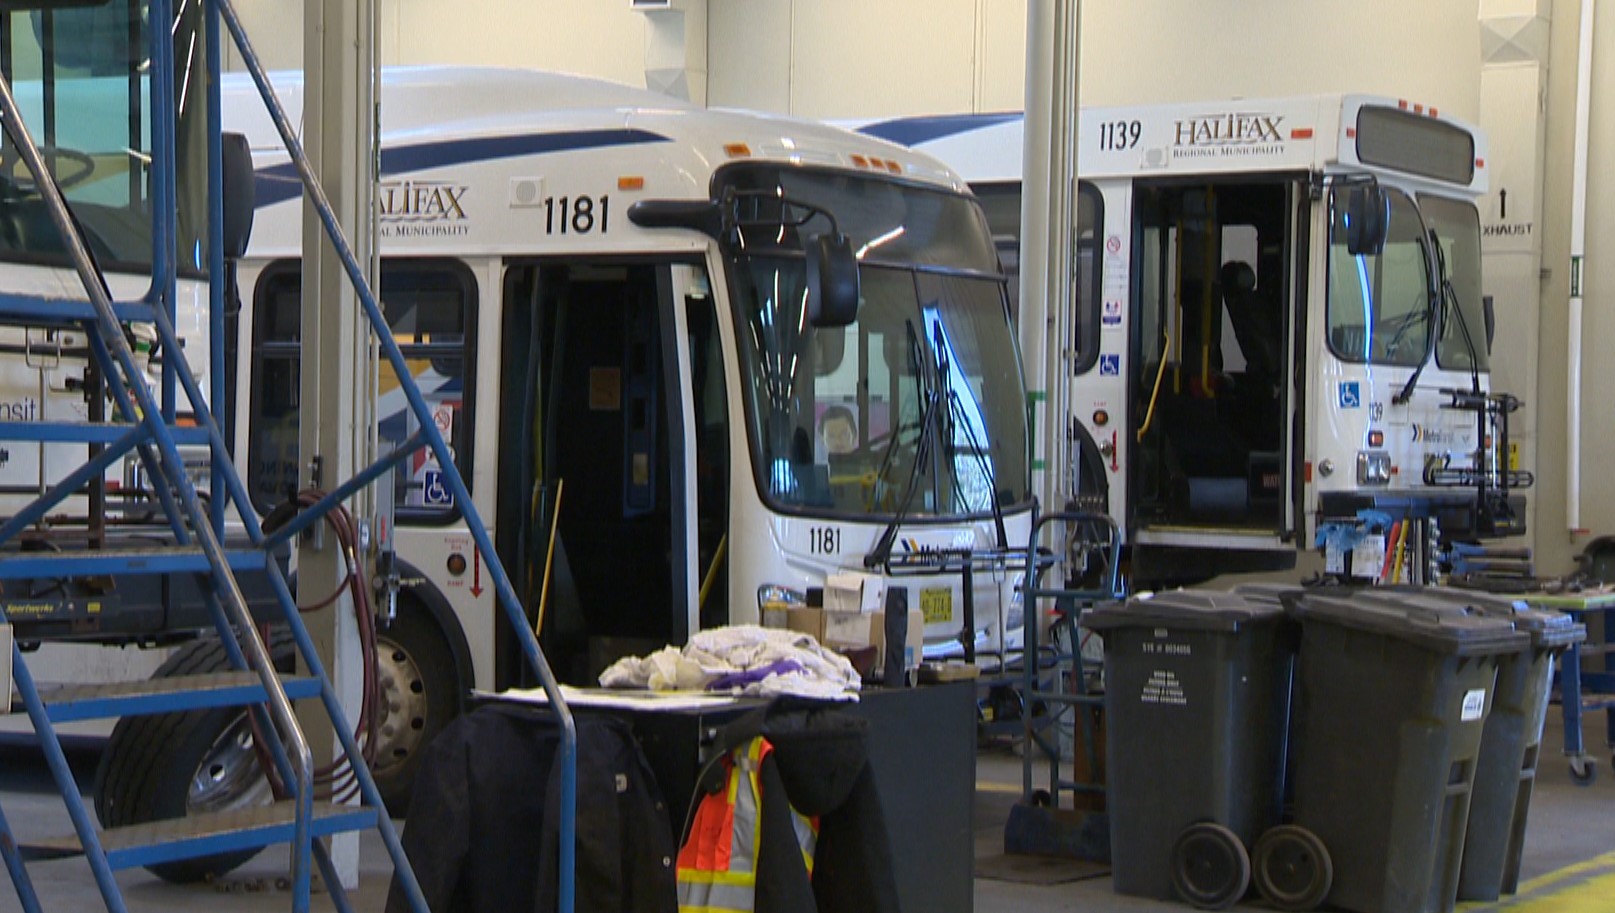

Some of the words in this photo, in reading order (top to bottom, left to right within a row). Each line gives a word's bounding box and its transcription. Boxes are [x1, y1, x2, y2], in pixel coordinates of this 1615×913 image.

[1100, 121, 1142, 151] 1139
[1174, 113, 1285, 145] HALIFAX
[380, 181, 469, 219] LIFAX
[545, 194, 608, 235] 1181
[1483, 223, 1533, 236] XHAUST
[0, 396, 36, 421] nsit
[810, 528, 841, 554] 1181
